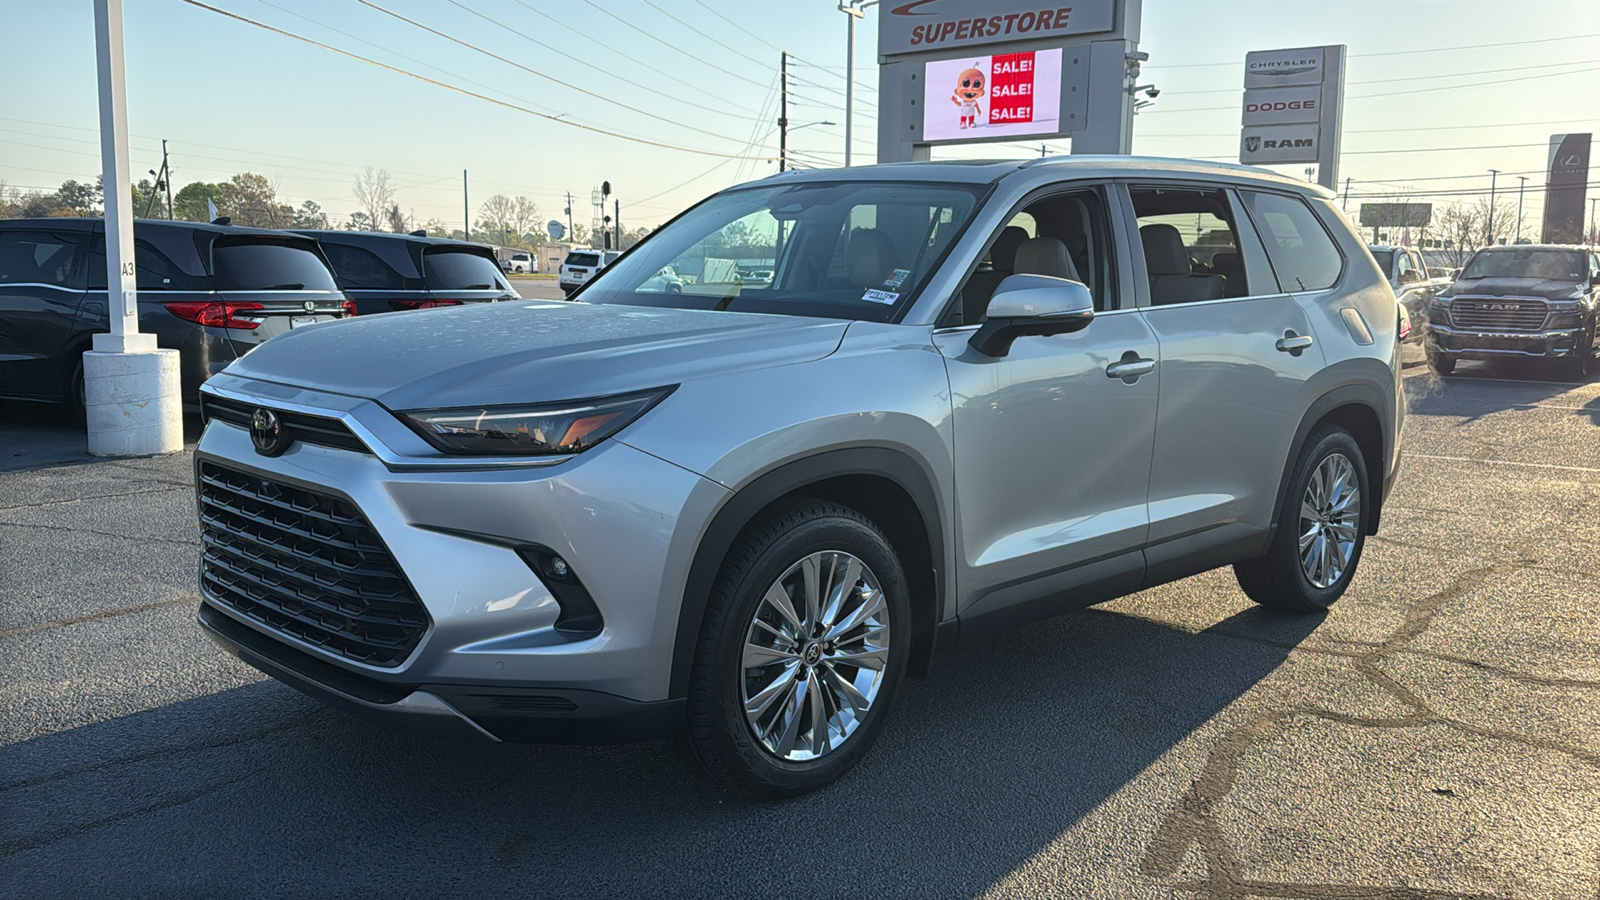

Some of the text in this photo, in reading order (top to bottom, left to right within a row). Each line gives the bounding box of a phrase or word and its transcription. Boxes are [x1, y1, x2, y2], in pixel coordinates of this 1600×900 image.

[910, 8, 1072, 45] SUPERSTORE
[993, 60, 1033, 74] SALE!
[1250, 59, 1316, 68] CHRYSLER
[992, 83, 1031, 97] SALE!
[991, 106, 1030, 120] SALE!
[1246, 100, 1316, 112] DODGE
[1263, 138, 1313, 149] RAM
[122, 262, 133, 276] A3
